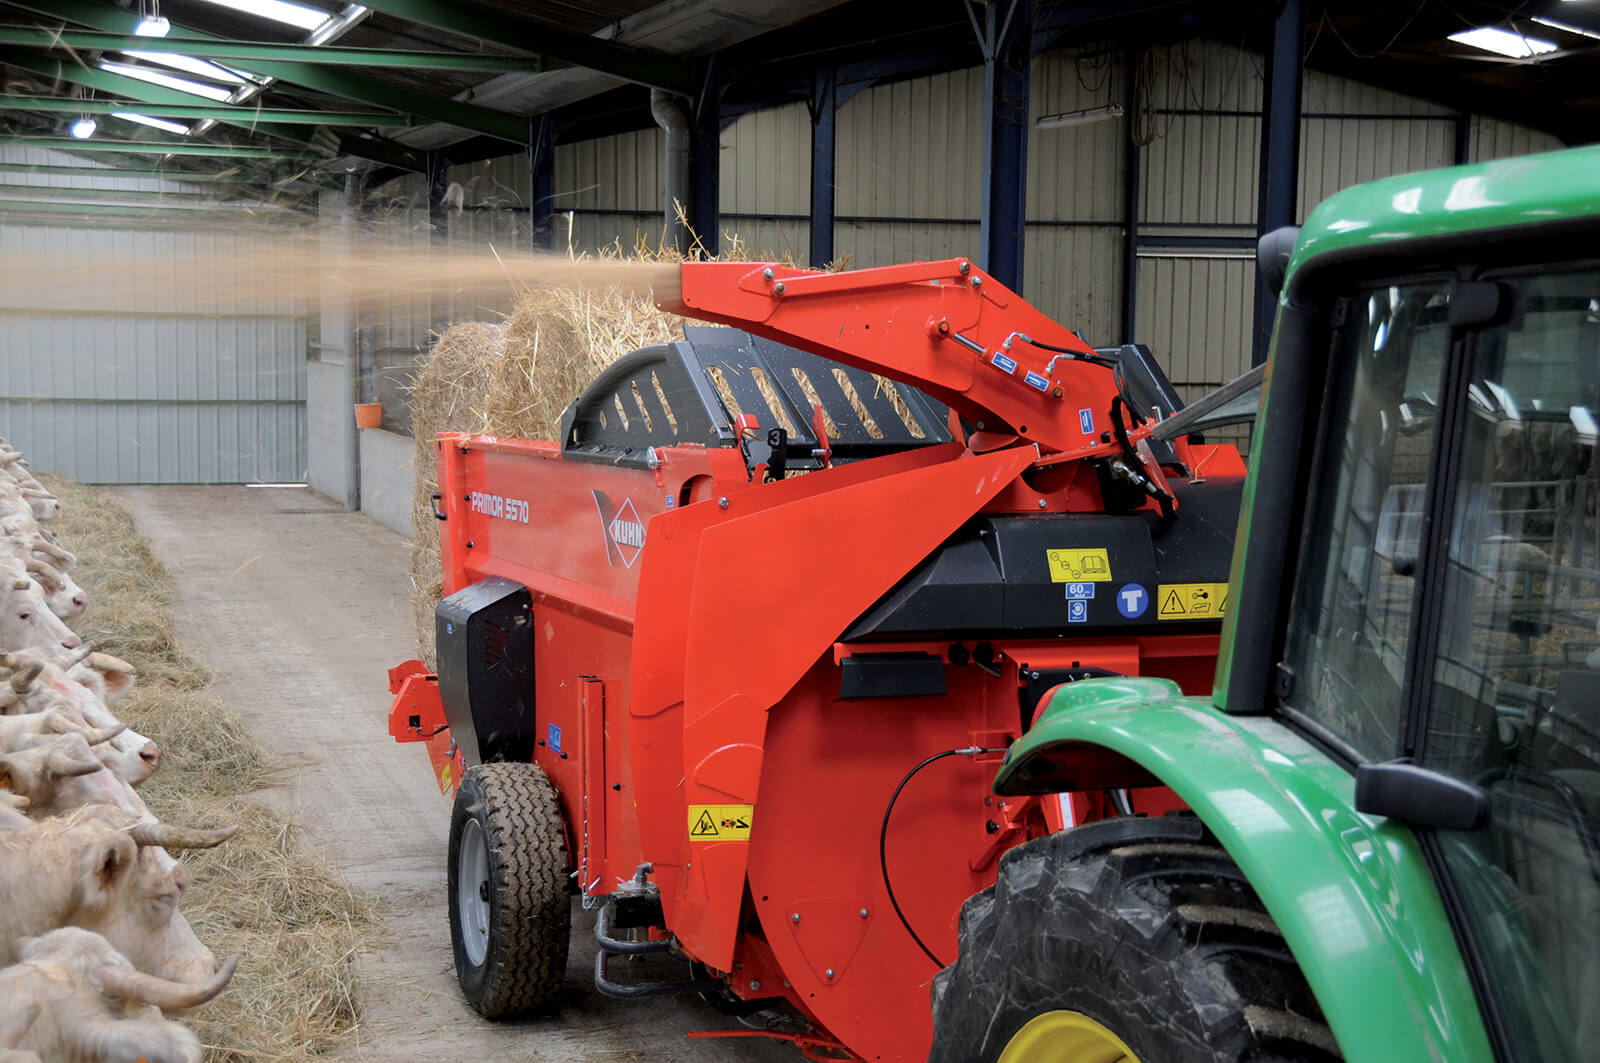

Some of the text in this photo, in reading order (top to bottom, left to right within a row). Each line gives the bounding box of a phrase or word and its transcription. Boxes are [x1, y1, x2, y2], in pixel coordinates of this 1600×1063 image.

[472, 491, 529, 524] PRIMOR 5570
[613, 519, 643, 548] KUHN
[1069, 584, 1084, 594] 60
